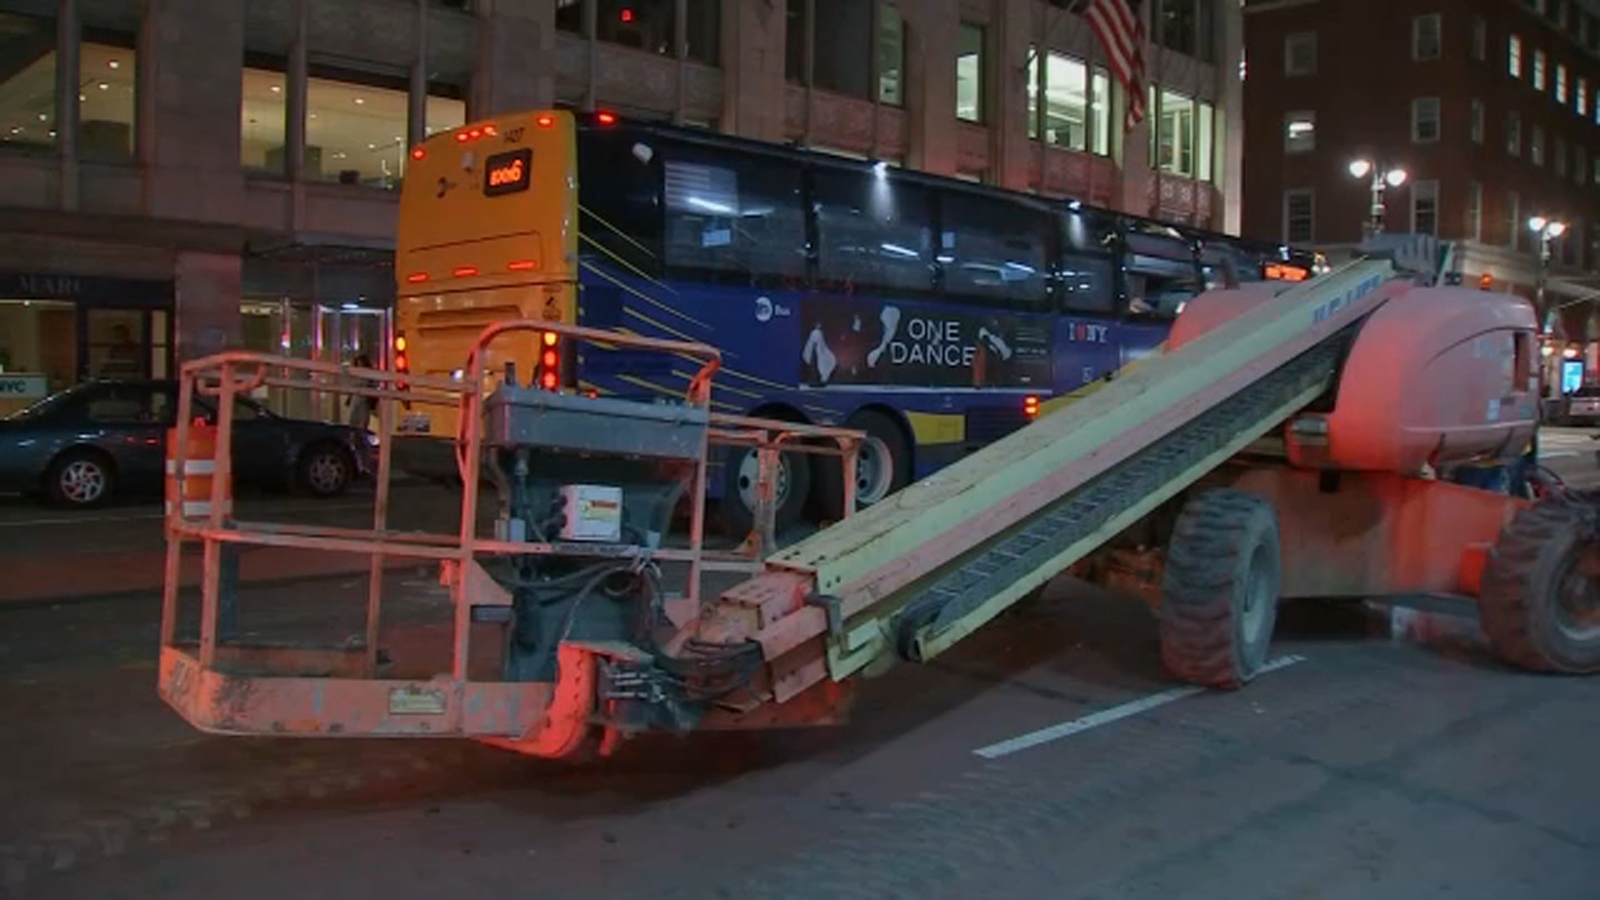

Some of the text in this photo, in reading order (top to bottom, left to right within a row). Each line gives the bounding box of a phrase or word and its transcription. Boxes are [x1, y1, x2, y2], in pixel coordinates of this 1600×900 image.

[908, 318, 960, 342] ONE
[1087, 323, 1108, 344] NY
[890, 342, 977, 367] DANCE
